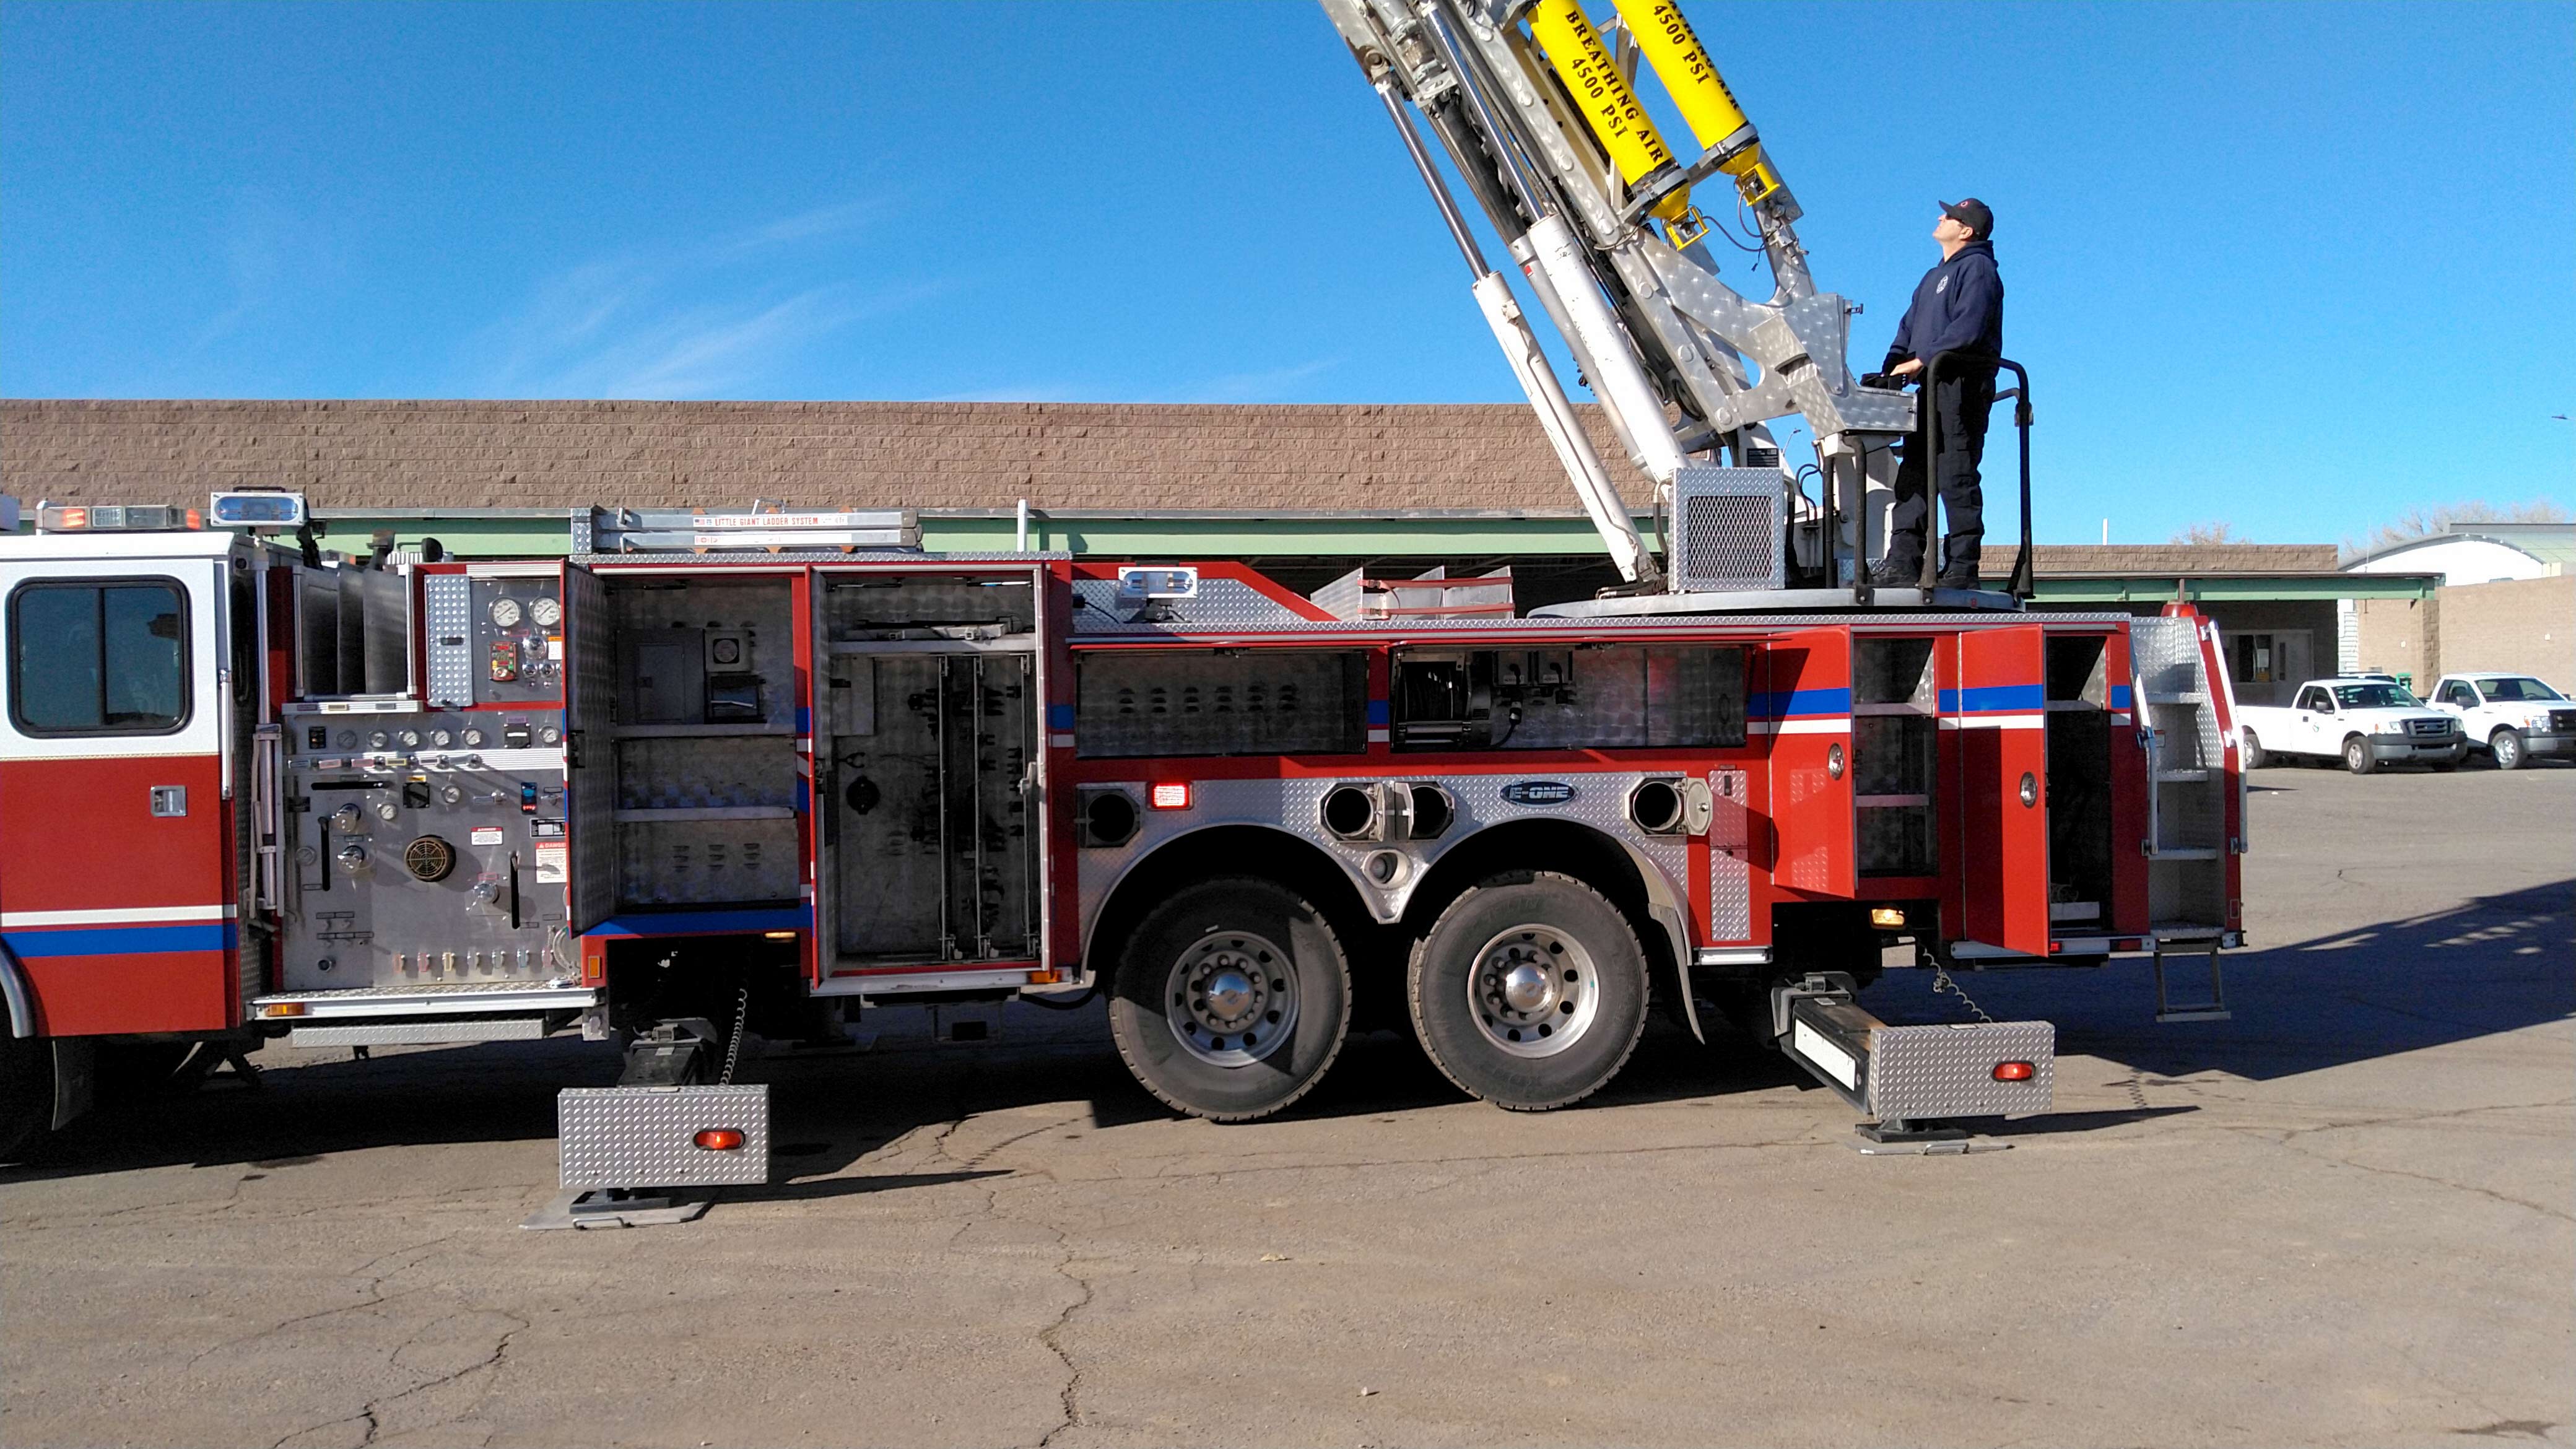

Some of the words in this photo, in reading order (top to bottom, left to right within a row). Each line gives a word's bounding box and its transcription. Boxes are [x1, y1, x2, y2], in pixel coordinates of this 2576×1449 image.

[1653, 6, 1686, 45] 4500
[1682, 50, 1710, 84] PSI
[1565, 10, 1639, 121] BREATHING
[1636, 129, 1664, 163] AIR
[1572, 59, 1604, 98] 4500
[1601, 103, 1629, 138] PSI
[715, 518, 736, 526] LITTLE
[740, 518, 760, 526] GIANT
[763, 517, 788, 526] LADDER
[792, 517, 818, 525] SYSTEM
[1509, 786, 1570, 799] E-ONE
